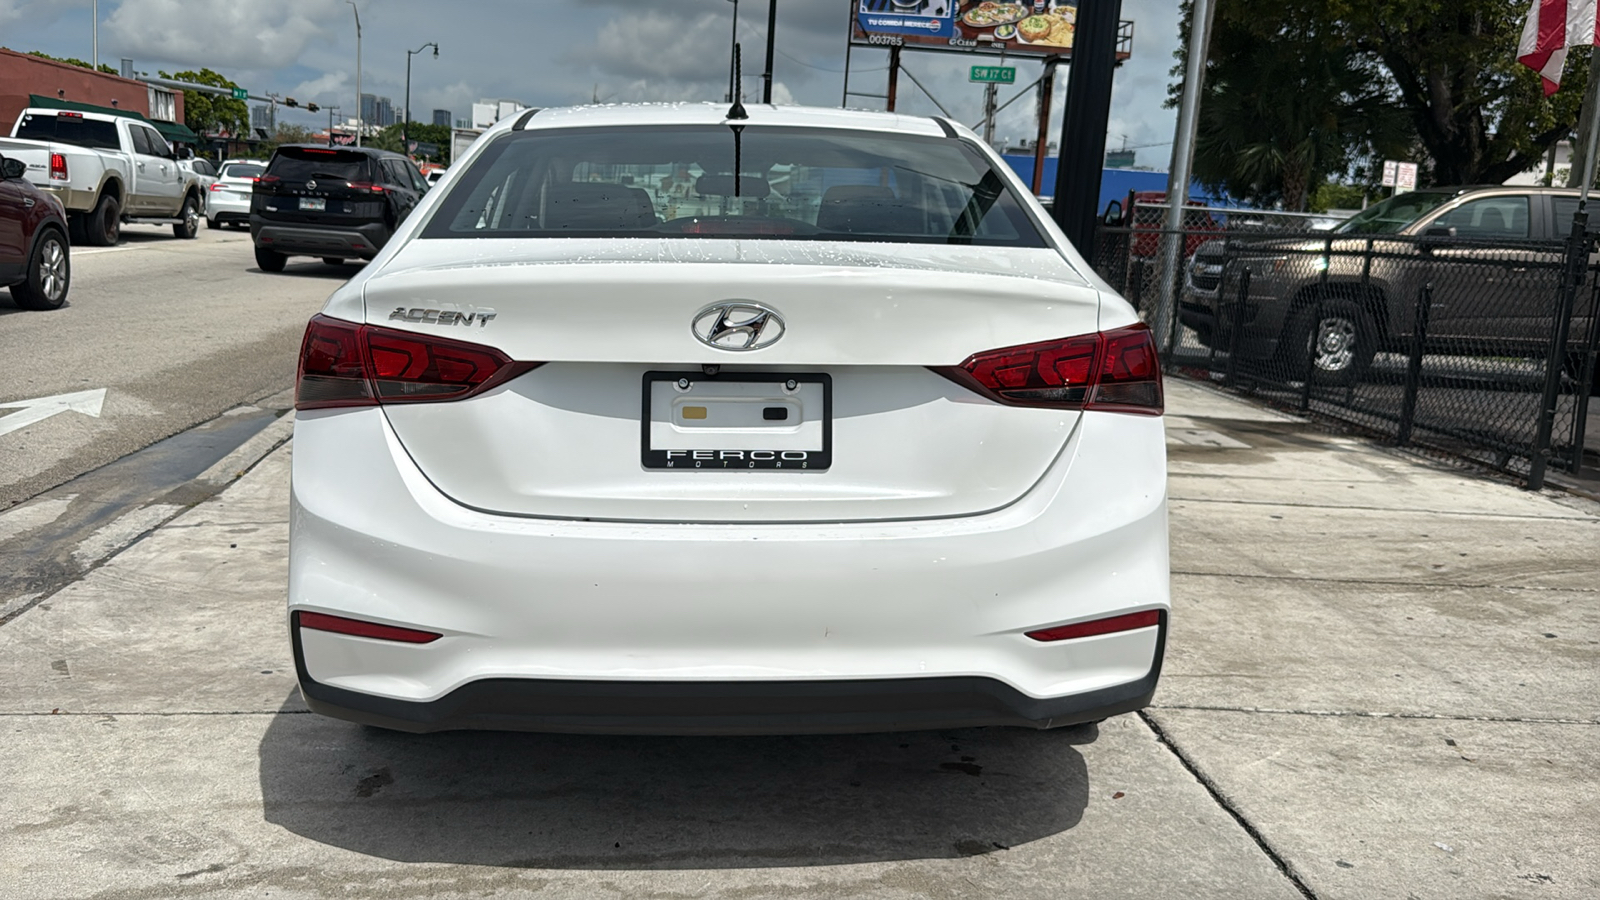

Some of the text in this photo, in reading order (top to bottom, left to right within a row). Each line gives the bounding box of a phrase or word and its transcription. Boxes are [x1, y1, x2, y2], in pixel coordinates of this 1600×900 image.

[878, 19, 903, 27] COMIDA
[868, 35, 903, 46] 003785
[974, 68, 988, 79] SW
[989, 69, 999, 79] 17
[388, 306, 497, 328] ACCENT
[666, 450, 808, 460] FERCO
